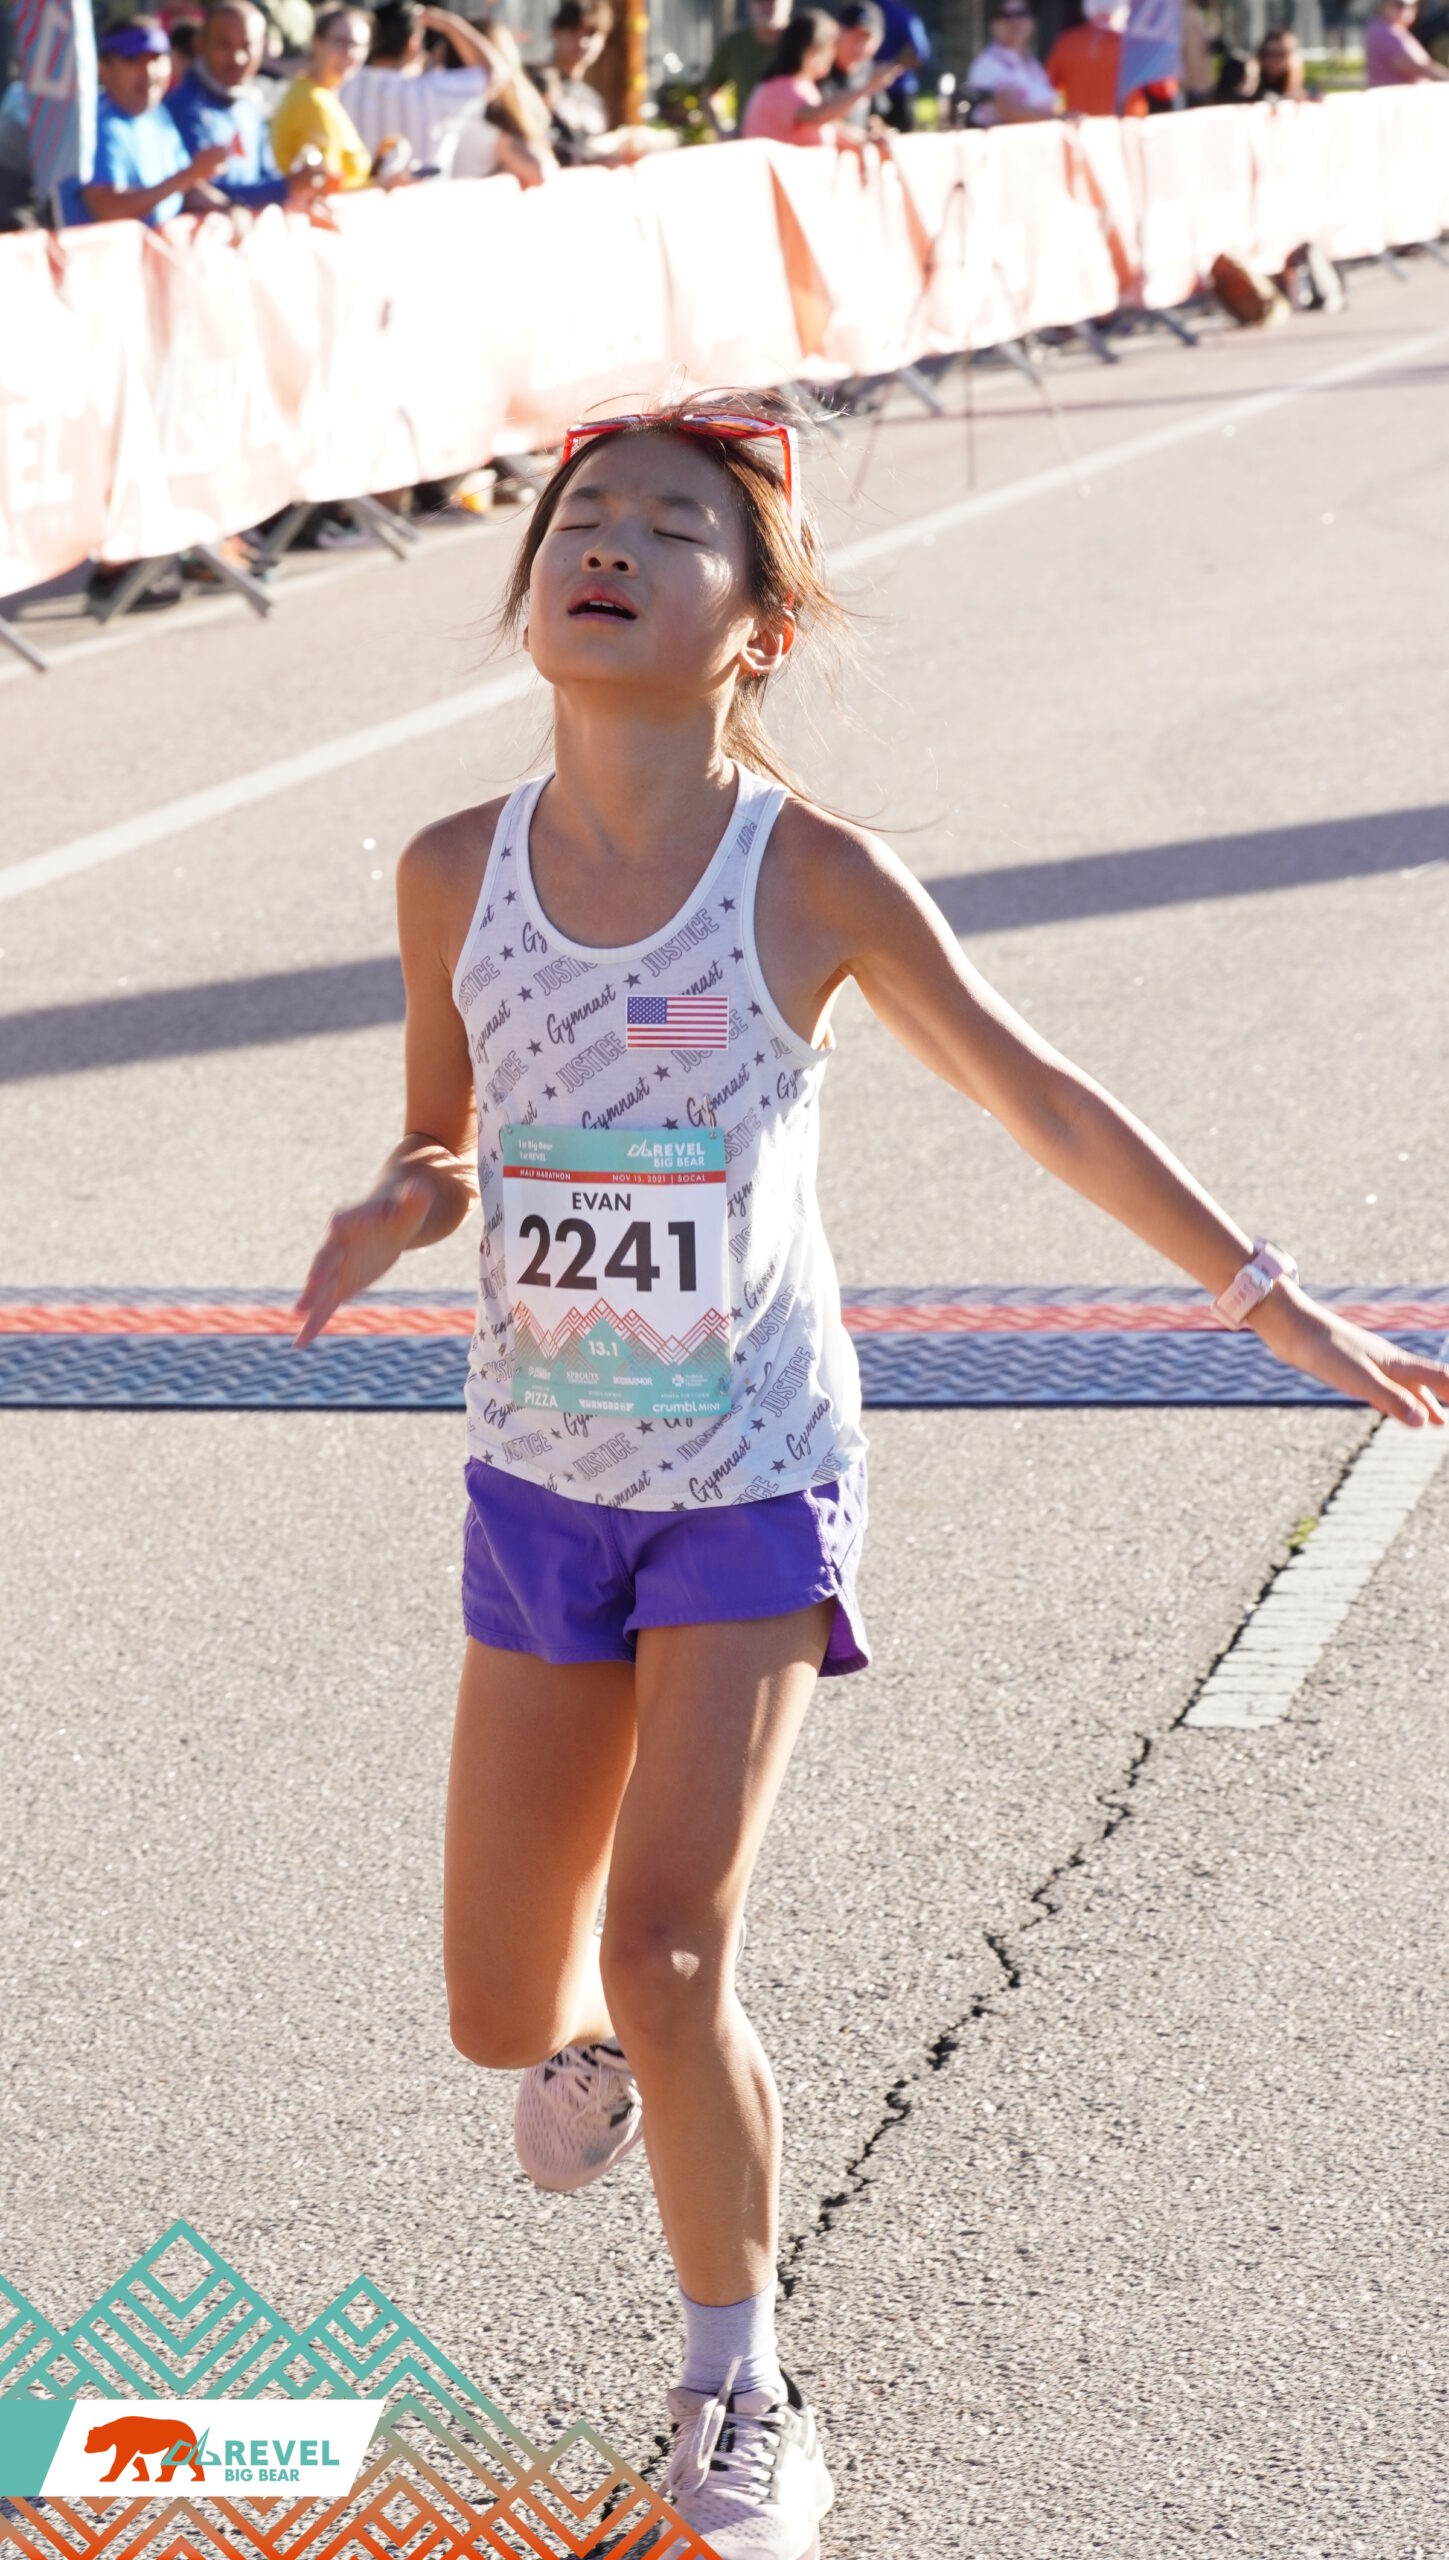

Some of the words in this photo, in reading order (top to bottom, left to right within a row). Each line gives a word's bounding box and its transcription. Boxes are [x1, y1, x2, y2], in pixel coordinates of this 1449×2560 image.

[641, 908, 720, 978] JUSTICE
[546, 983, 616, 1044] Gymnast
[556, 1031, 628, 1094] JUSTICE
[686, 1063, 749, 1128] Gymnast
[527, 1140, 538, 1151] Big
[654, 1143, 705, 1157] REVEL
[654, 1157, 673, 1168] BIG
[677, 1156, 705, 1168] BEAR
[520, 1168, 535, 1177] HALF
[536, 1170, 571, 1181] MARATHON
[612, 1174, 631, 1182] NOV
[647, 1175, 666, 1184] 2021
[677, 1174, 706, 1183] SOCAL
[571, 1192, 632, 1212] EVAN
[516, 1213, 697, 1293] 2241
[588, 1340, 619, 1357] 13.1
[524, 1390, 559, 1409] PIZZA
[652, 1401, 697, 1413] crumbl
[698, 1402, 721, 1411] MINI
[689, 1434, 751, 1504] Gymnast
